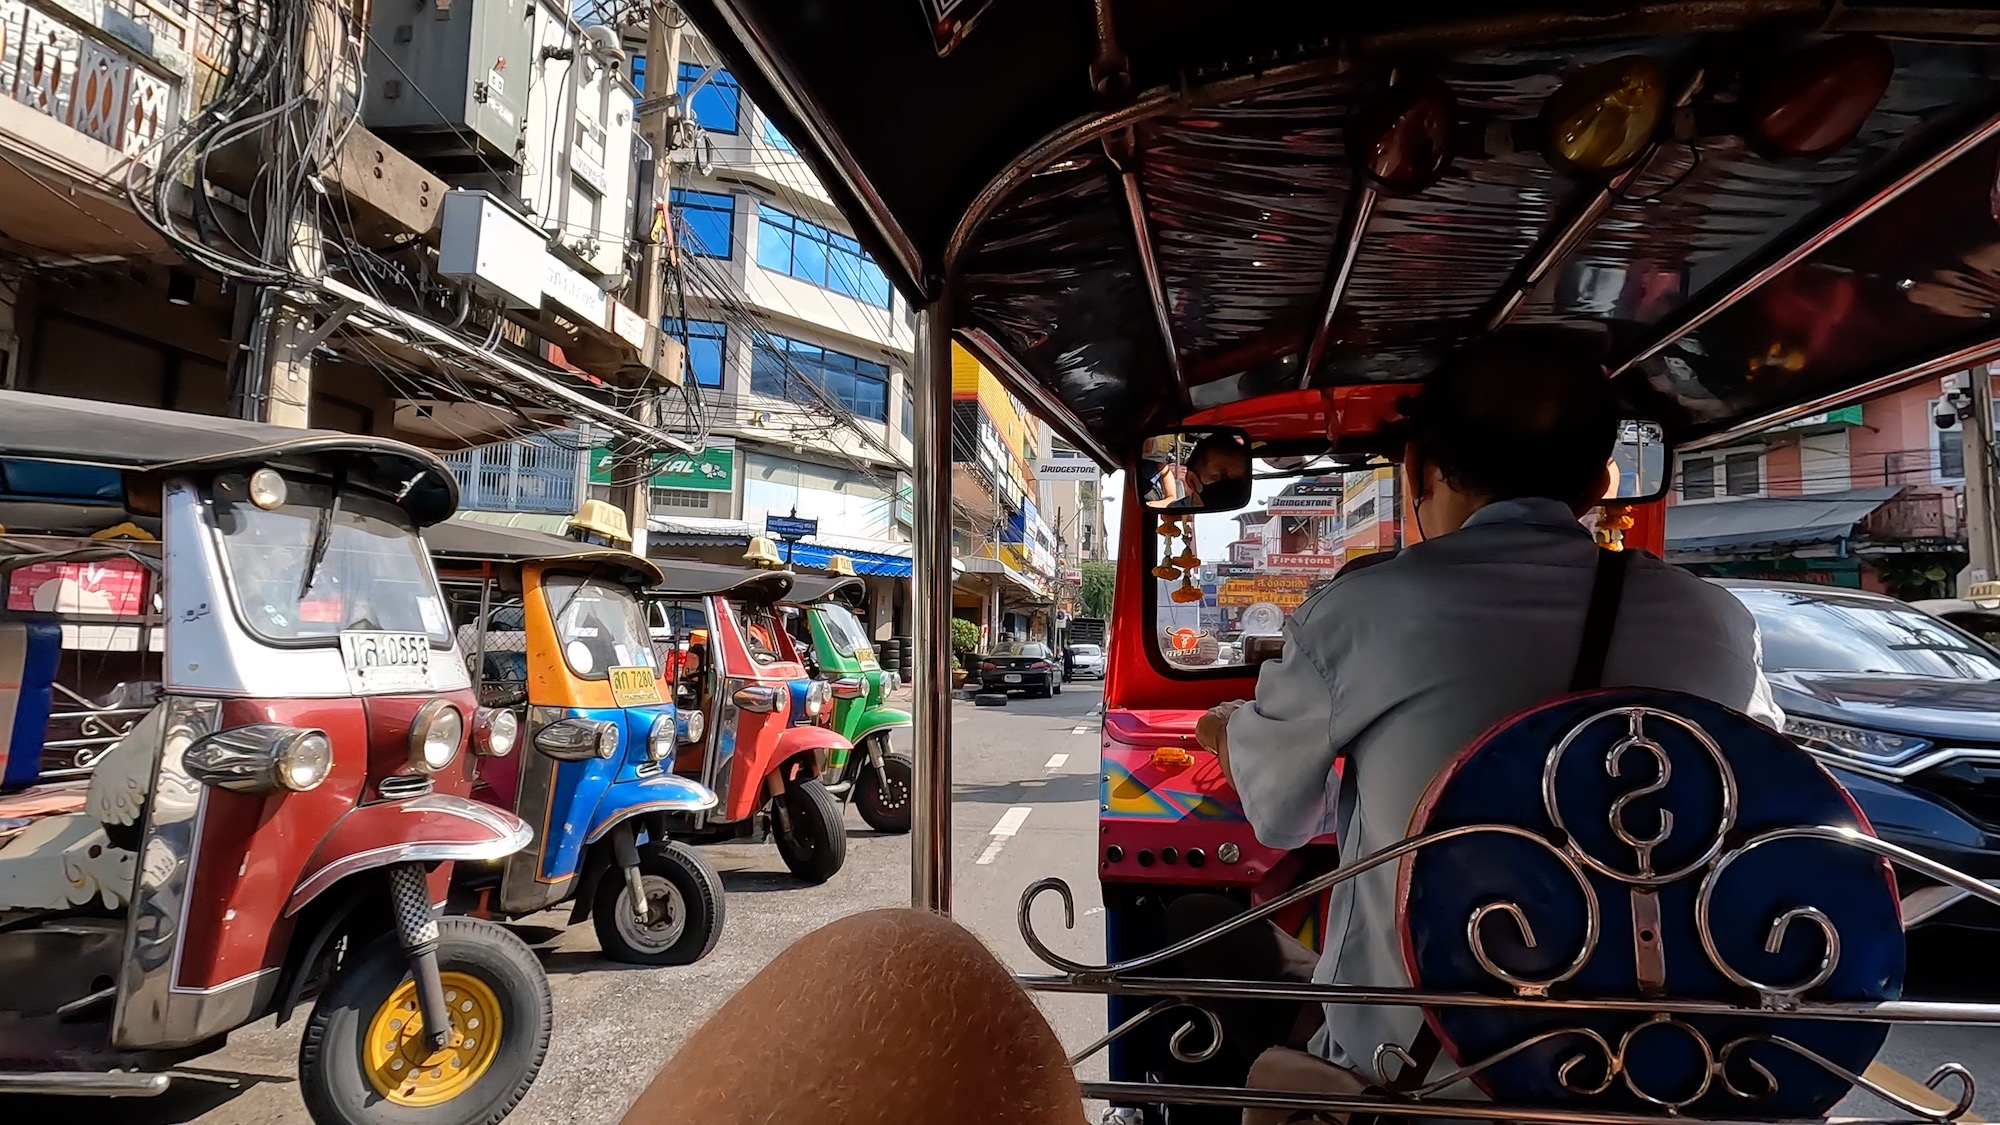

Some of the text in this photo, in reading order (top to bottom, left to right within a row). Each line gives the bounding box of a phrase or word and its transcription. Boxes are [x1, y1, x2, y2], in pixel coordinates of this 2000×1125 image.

[1040, 464, 1096, 474] BRIDGESTONE
[1272, 499, 1332, 507] BRIDGESTONE
[599, 510, 623, 530] TAXI
[1271, 556, 1331, 565] Firestone
[631, 670, 653, 688] 7280
